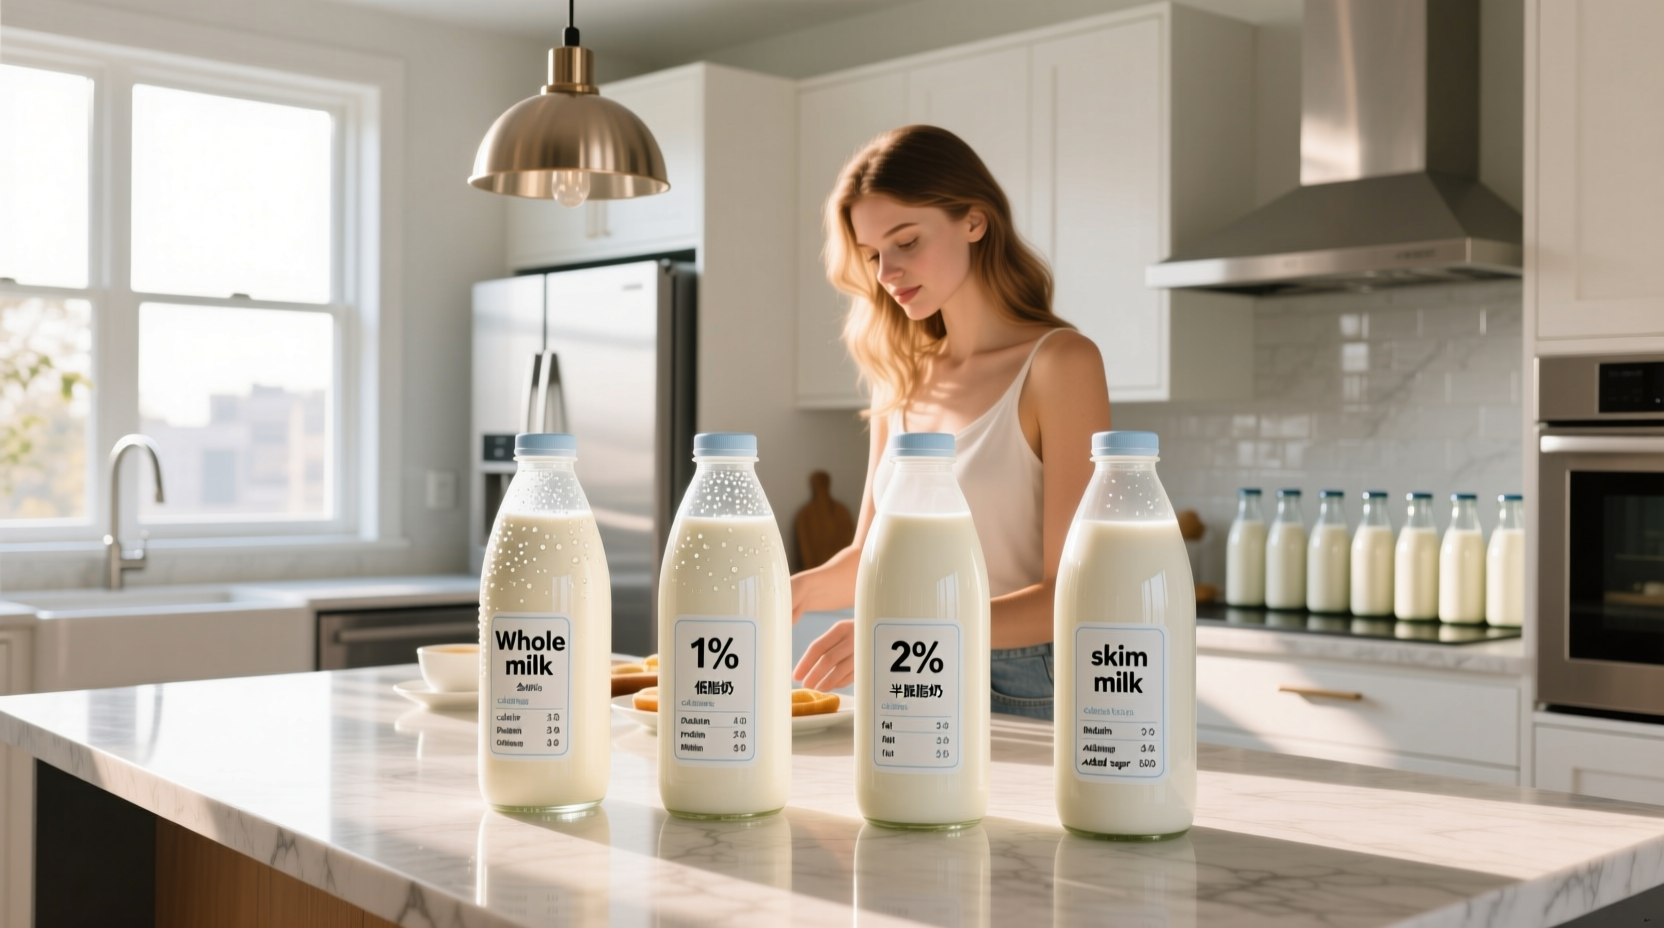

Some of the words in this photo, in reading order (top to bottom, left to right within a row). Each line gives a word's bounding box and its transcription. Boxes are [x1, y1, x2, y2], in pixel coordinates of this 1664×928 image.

[495, 629, 566, 651] Whole
[690, 637, 739, 669] 1%
[890, 640, 944, 673] 2%
[1091, 644, 1148, 667] skim
[506, 654, 553, 676] milk
[1094, 671, 1143, 693] milk
